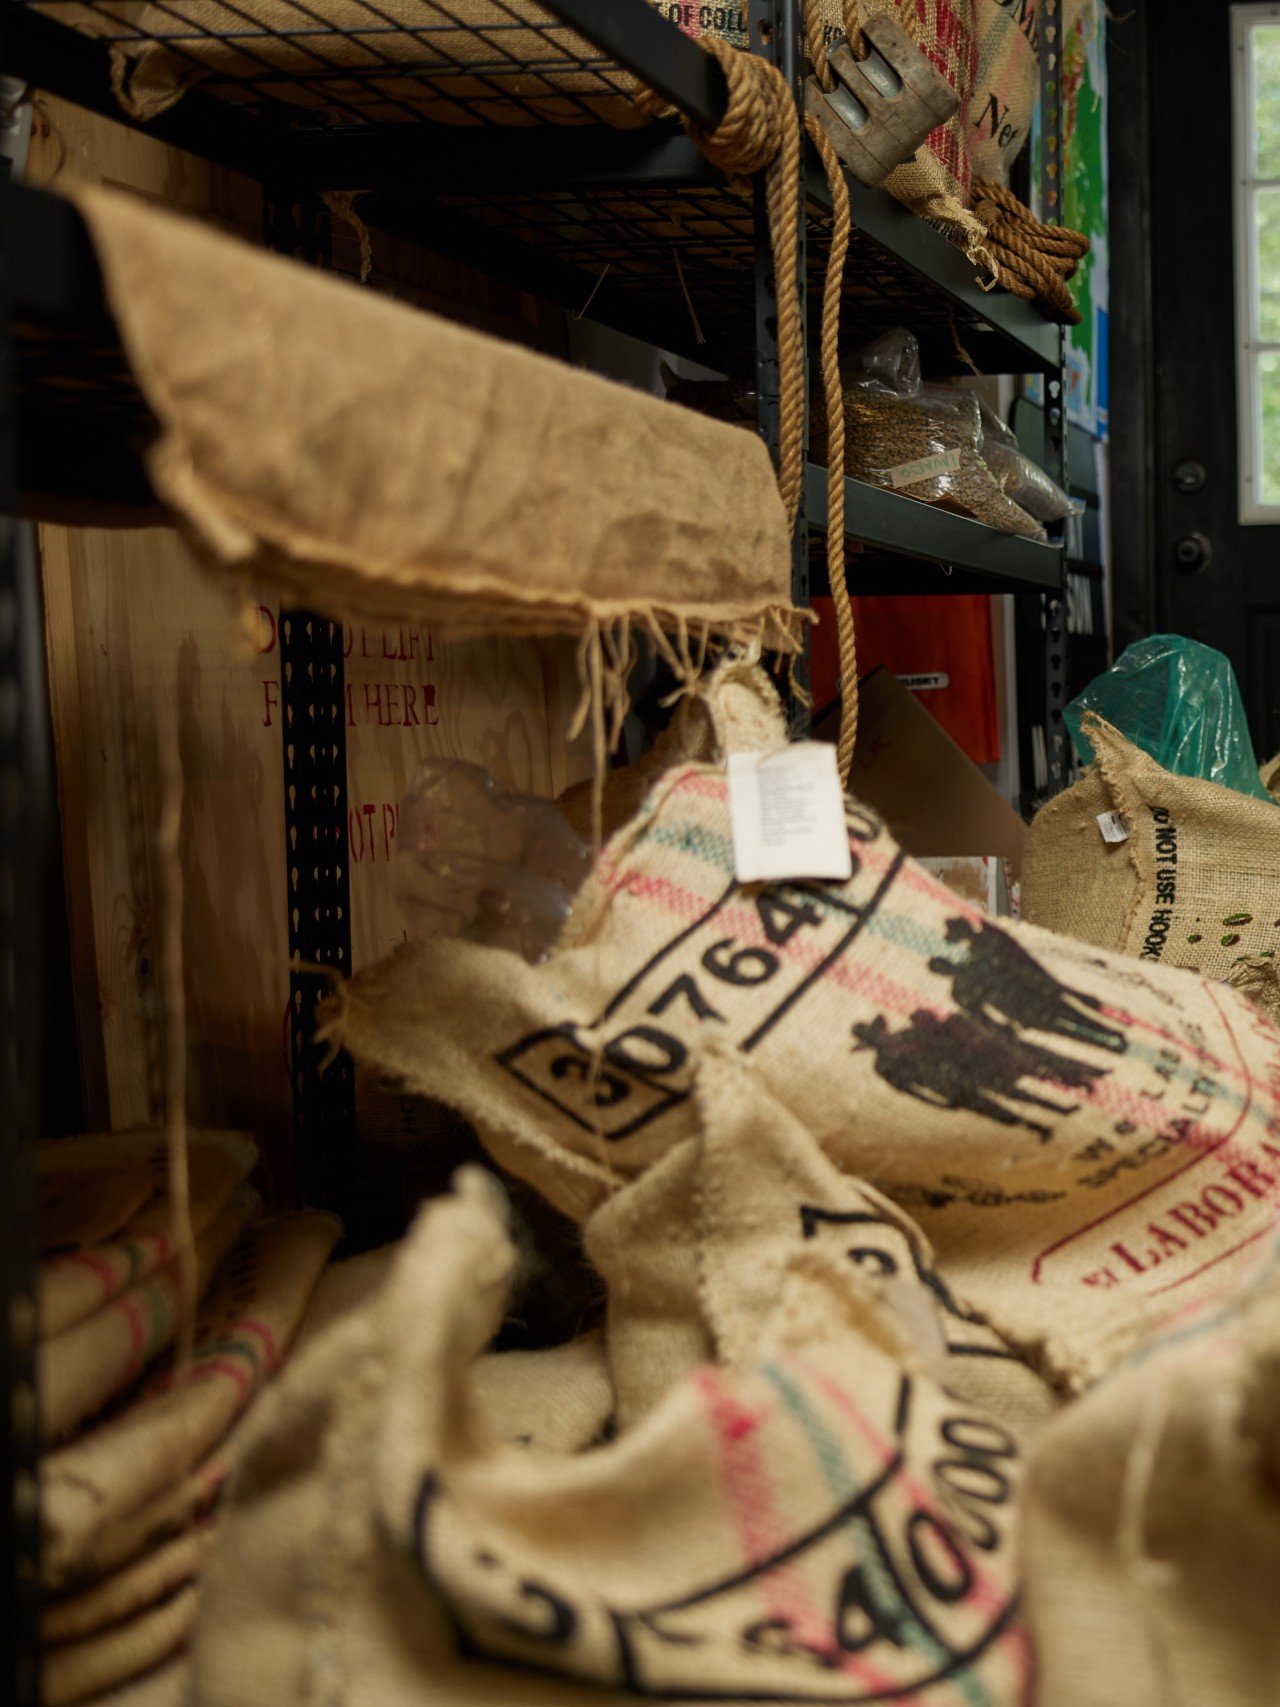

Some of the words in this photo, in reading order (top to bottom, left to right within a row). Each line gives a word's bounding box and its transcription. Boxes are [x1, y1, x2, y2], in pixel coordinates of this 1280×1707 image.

[362, 683, 439, 728] HERE
[1155, 827, 1178, 865] NOT
[1155, 868, 1177, 905] USE
[1138, 908, 1173, 963] HOOK
